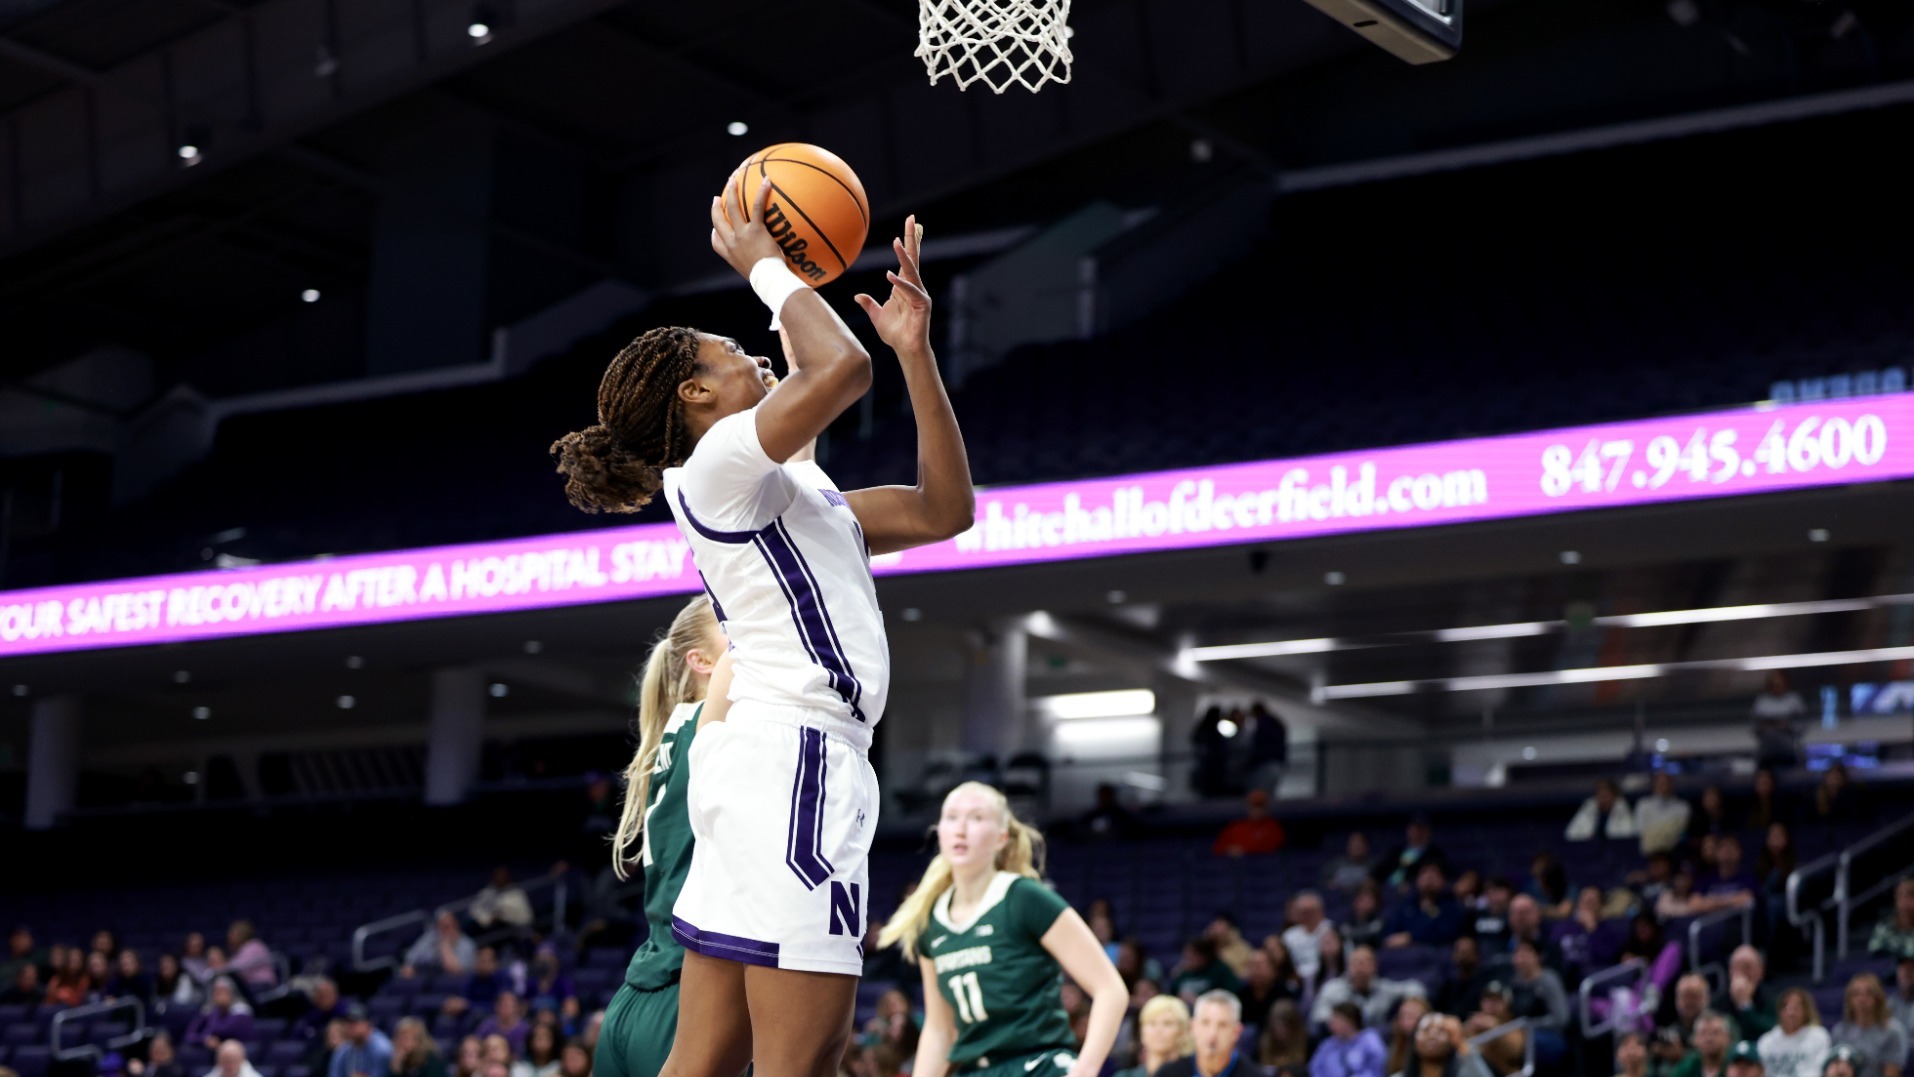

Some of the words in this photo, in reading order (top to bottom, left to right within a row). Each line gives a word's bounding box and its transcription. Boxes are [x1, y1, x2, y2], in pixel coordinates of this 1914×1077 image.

[764, 202, 827, 282] Wilson
[1540, 413, 1888, 498] 847.945.4600
[0, 599, 64, 642] OUR
[66, 589, 166, 635] SAFEST
[166, 573, 323, 627] RECOVERY
[320, 565, 418, 612] AFTER
[418, 562, 448, 602] A
[449, 546, 609, 600] HOSPITAL
[611, 537, 691, 584] STAY
[829, 881, 860, 937] N
[948, 971, 989, 1024] 11
